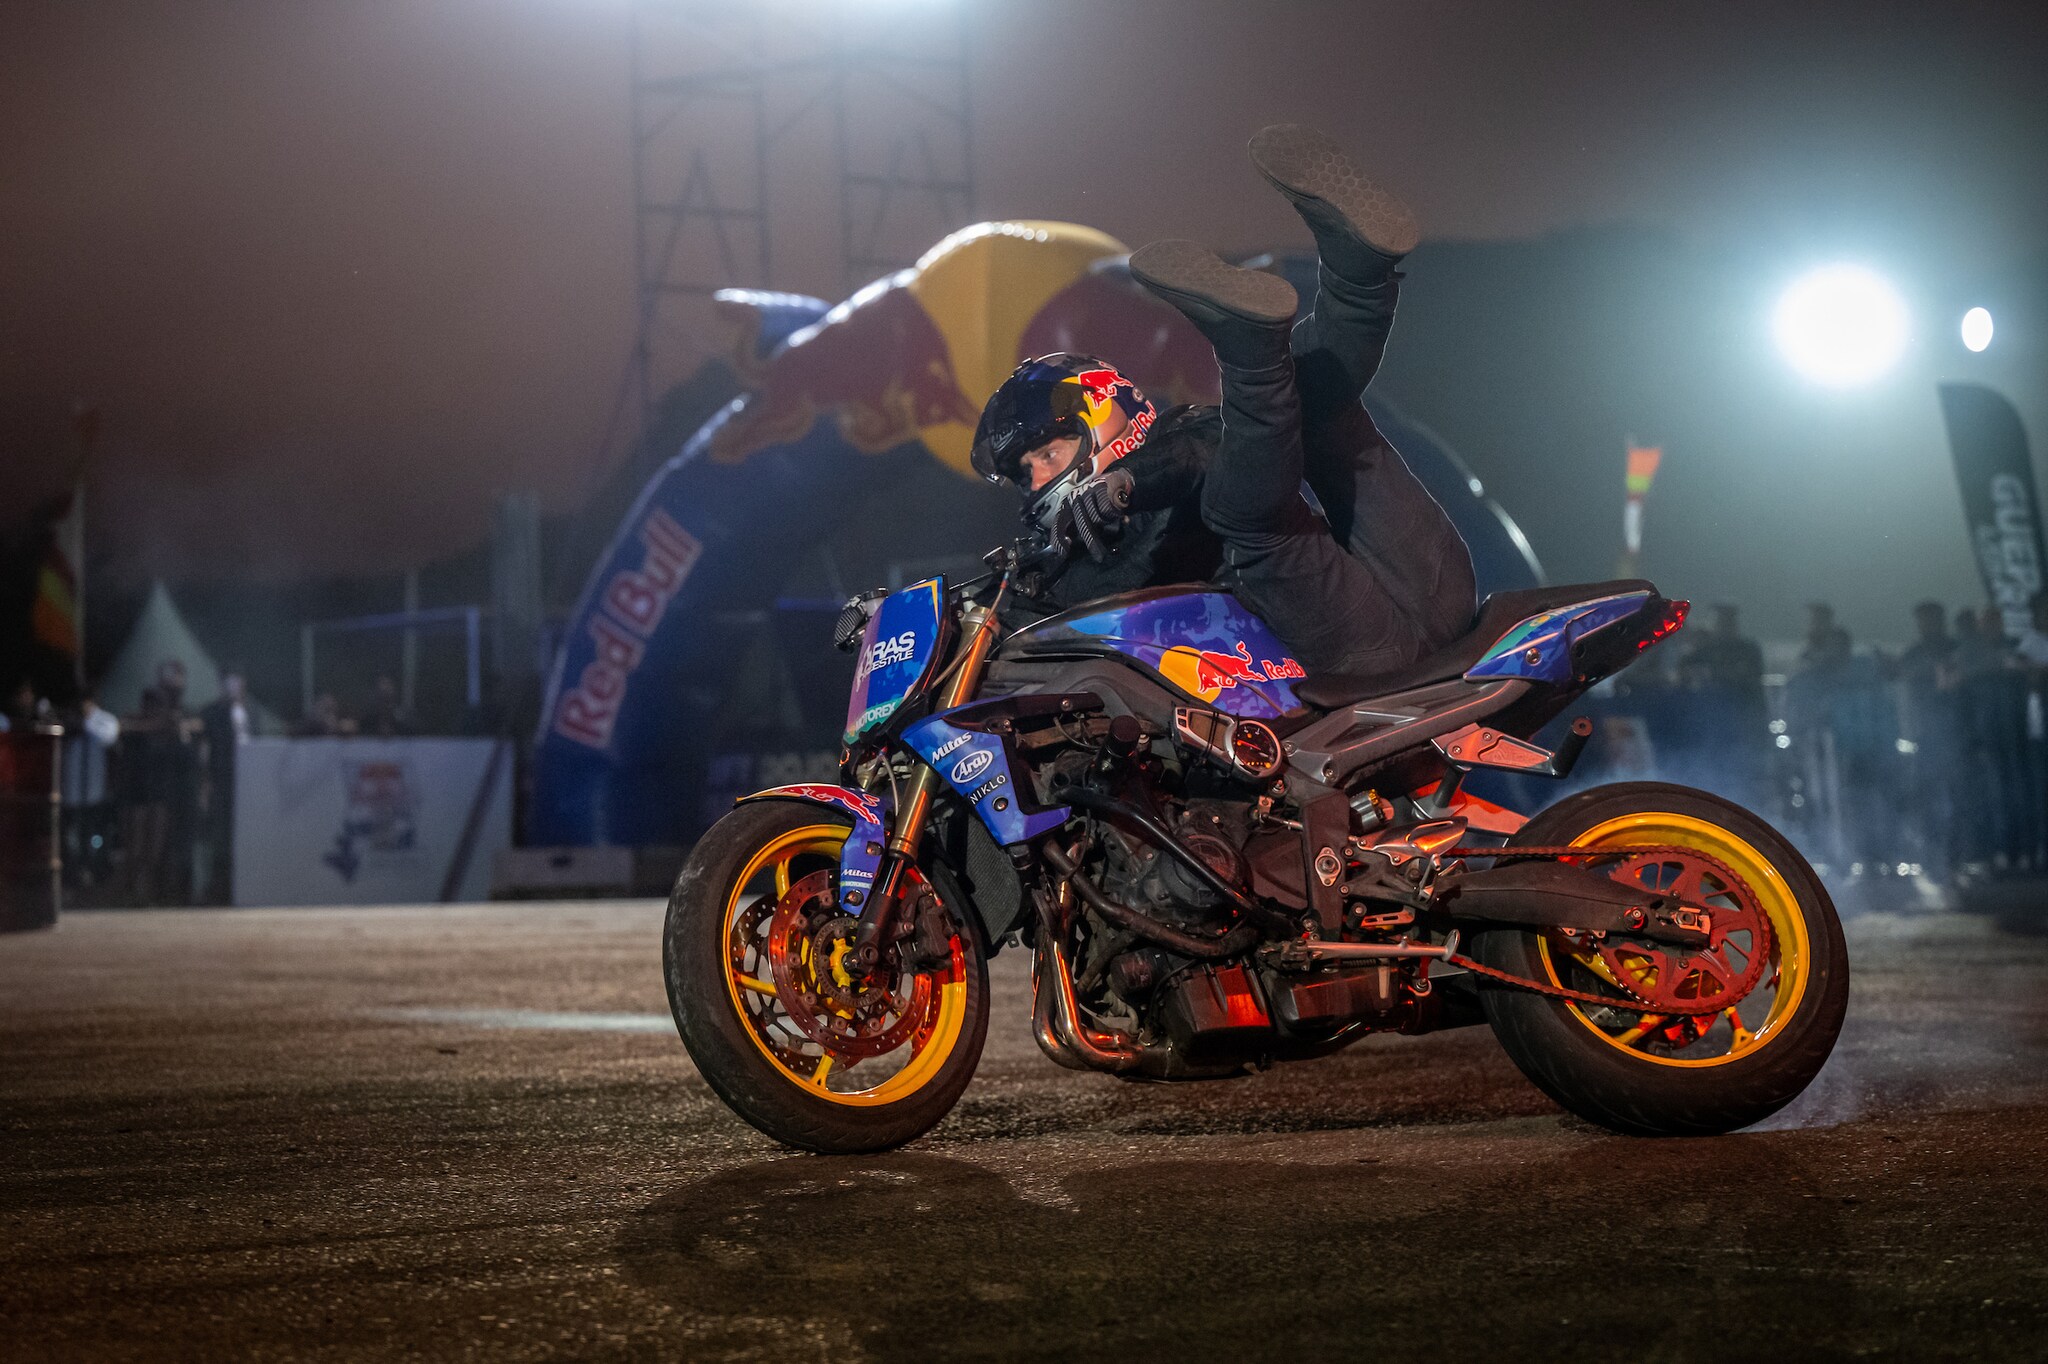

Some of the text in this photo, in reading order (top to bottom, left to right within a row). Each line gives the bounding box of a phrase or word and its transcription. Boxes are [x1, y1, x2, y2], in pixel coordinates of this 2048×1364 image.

[1109, 418, 1147, 459] Red
[555, 508, 704, 749] Red Bull
[1261, 658, 1297, 679] Red
[855, 702, 897, 731] MOTOREX
[932, 732, 972, 764] Mitas
[956, 752, 988, 780] Arai
[970, 775, 1006, 805] NIKLO
[841, 868, 874, 879] Mitas
